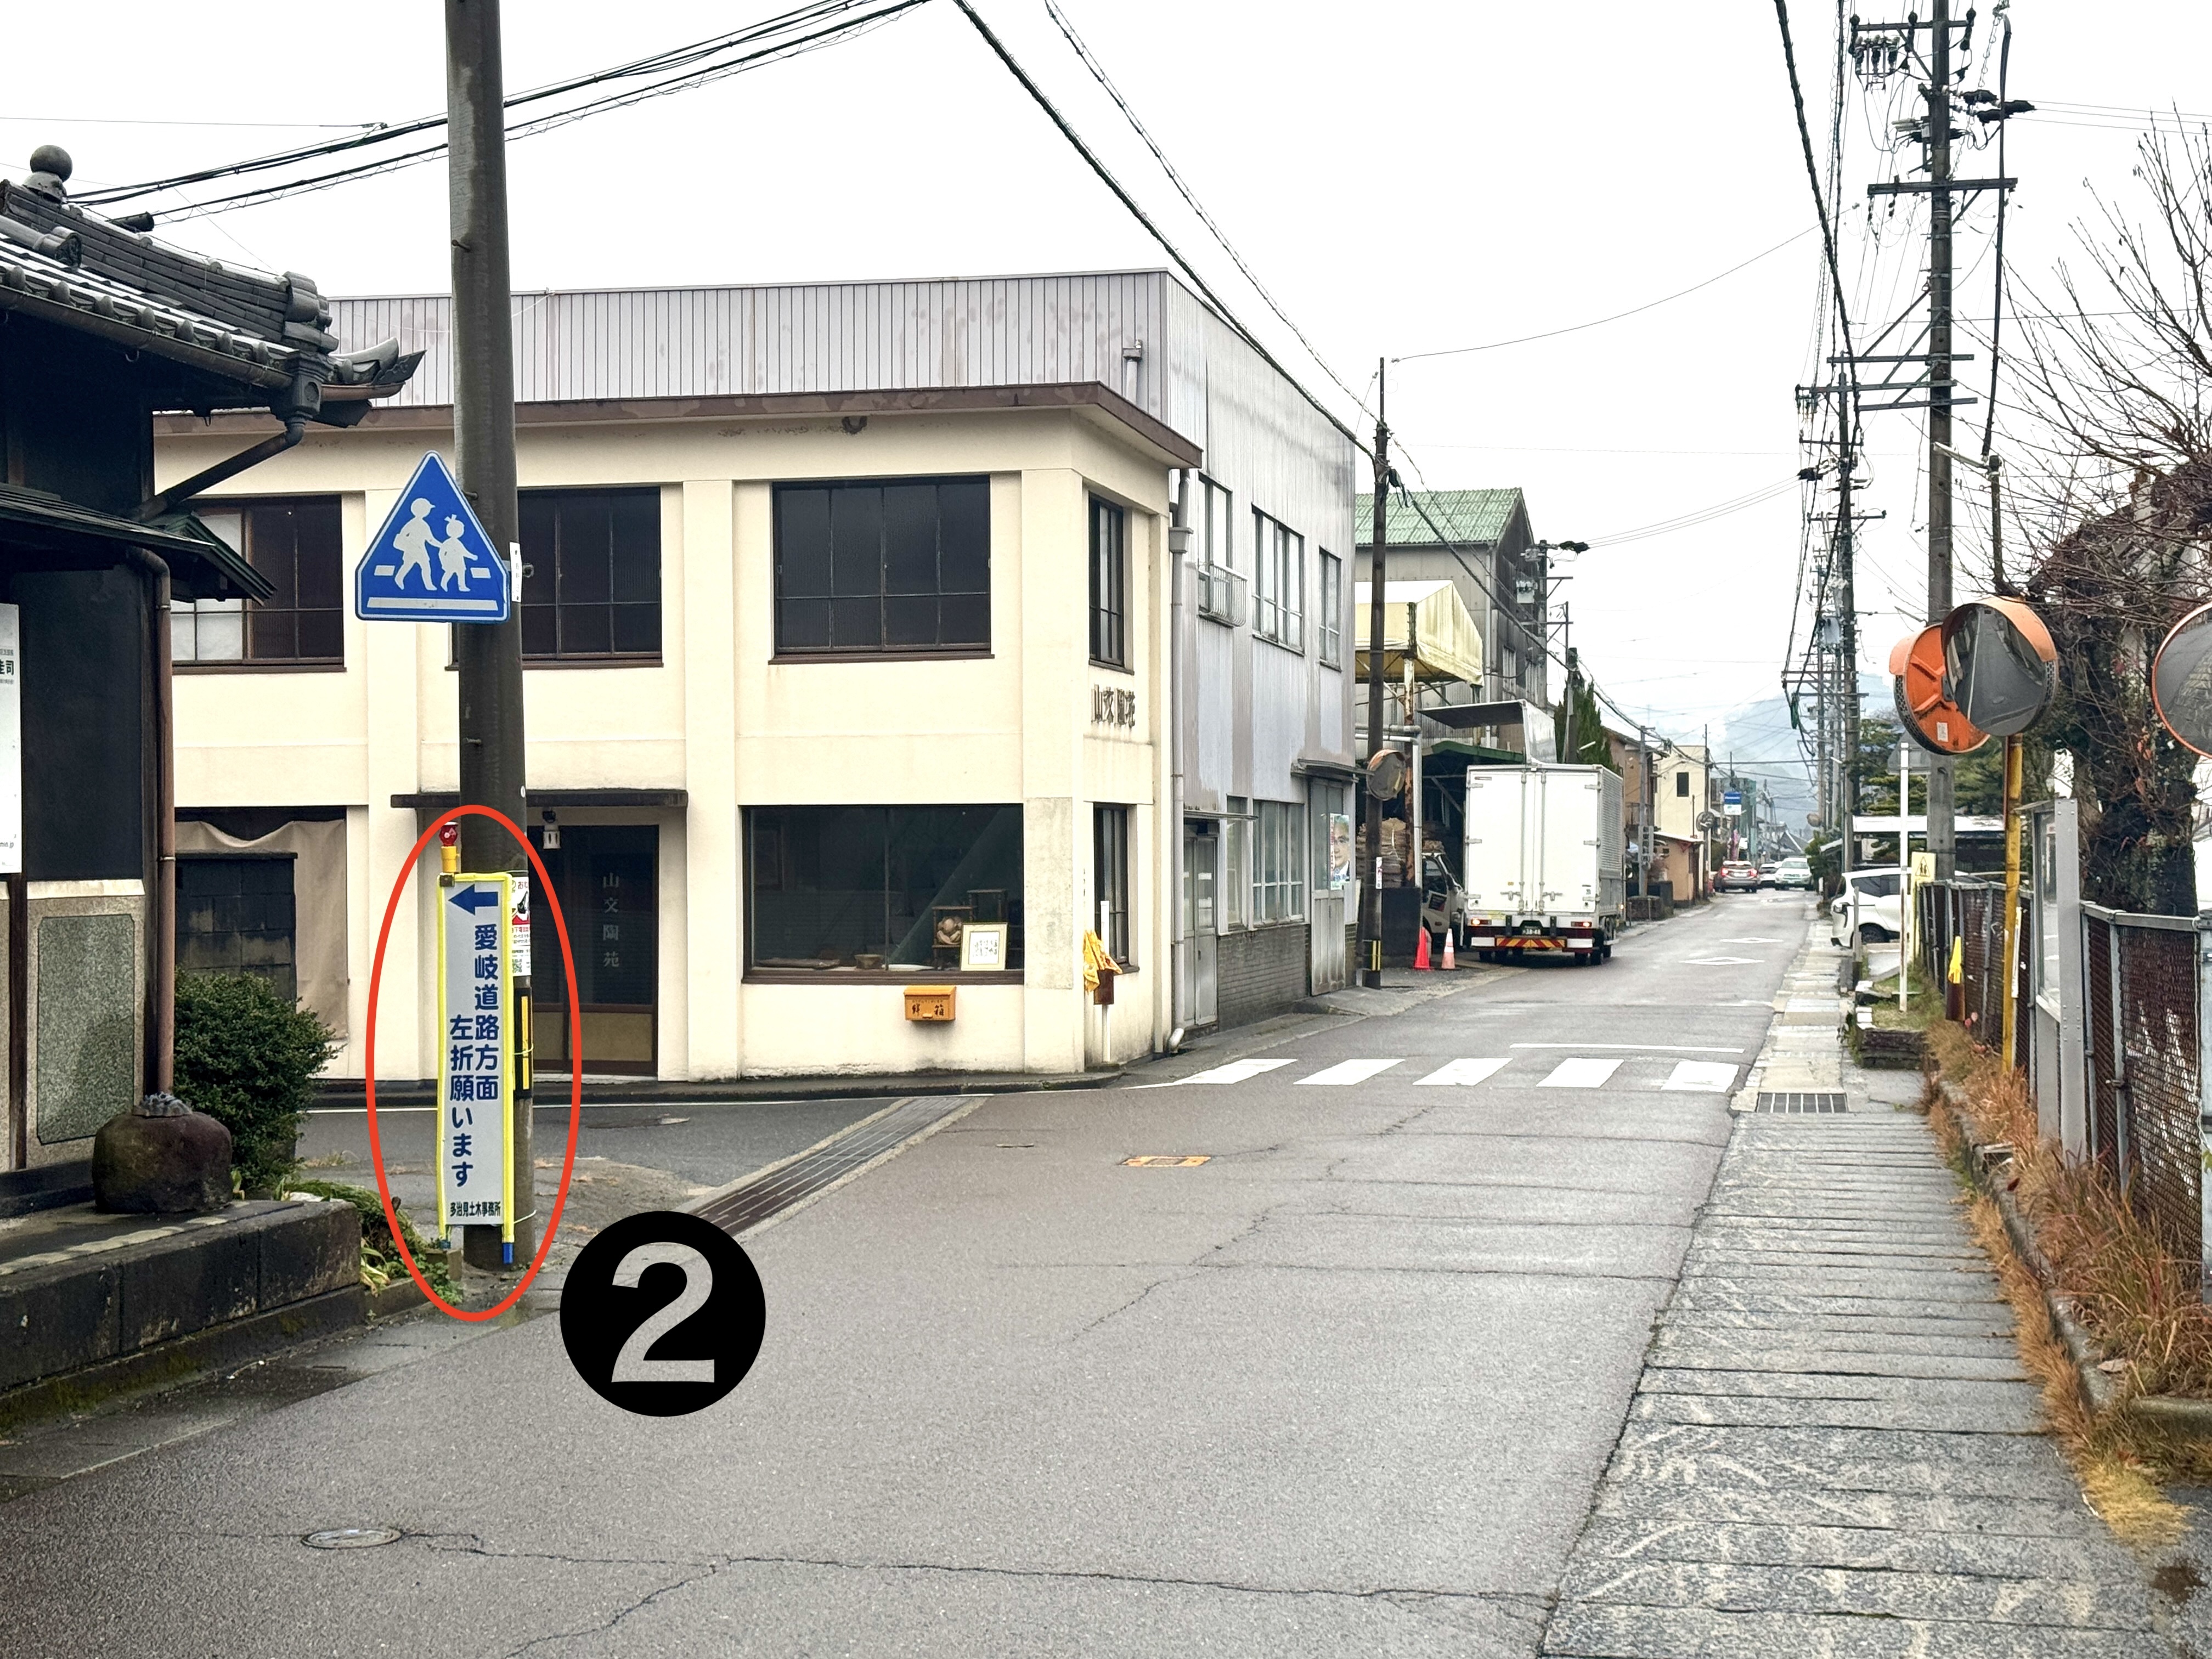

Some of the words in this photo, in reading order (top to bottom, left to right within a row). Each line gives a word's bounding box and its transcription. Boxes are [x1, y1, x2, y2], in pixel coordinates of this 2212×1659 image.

[602, 872, 620, 968] 山文陶苑
[475, 924, 499, 1101] 愛岐道路方面
[449, 1014, 474, 1187] 左折願います
[450, 1200, 501, 1217] 多治見土木事務所
